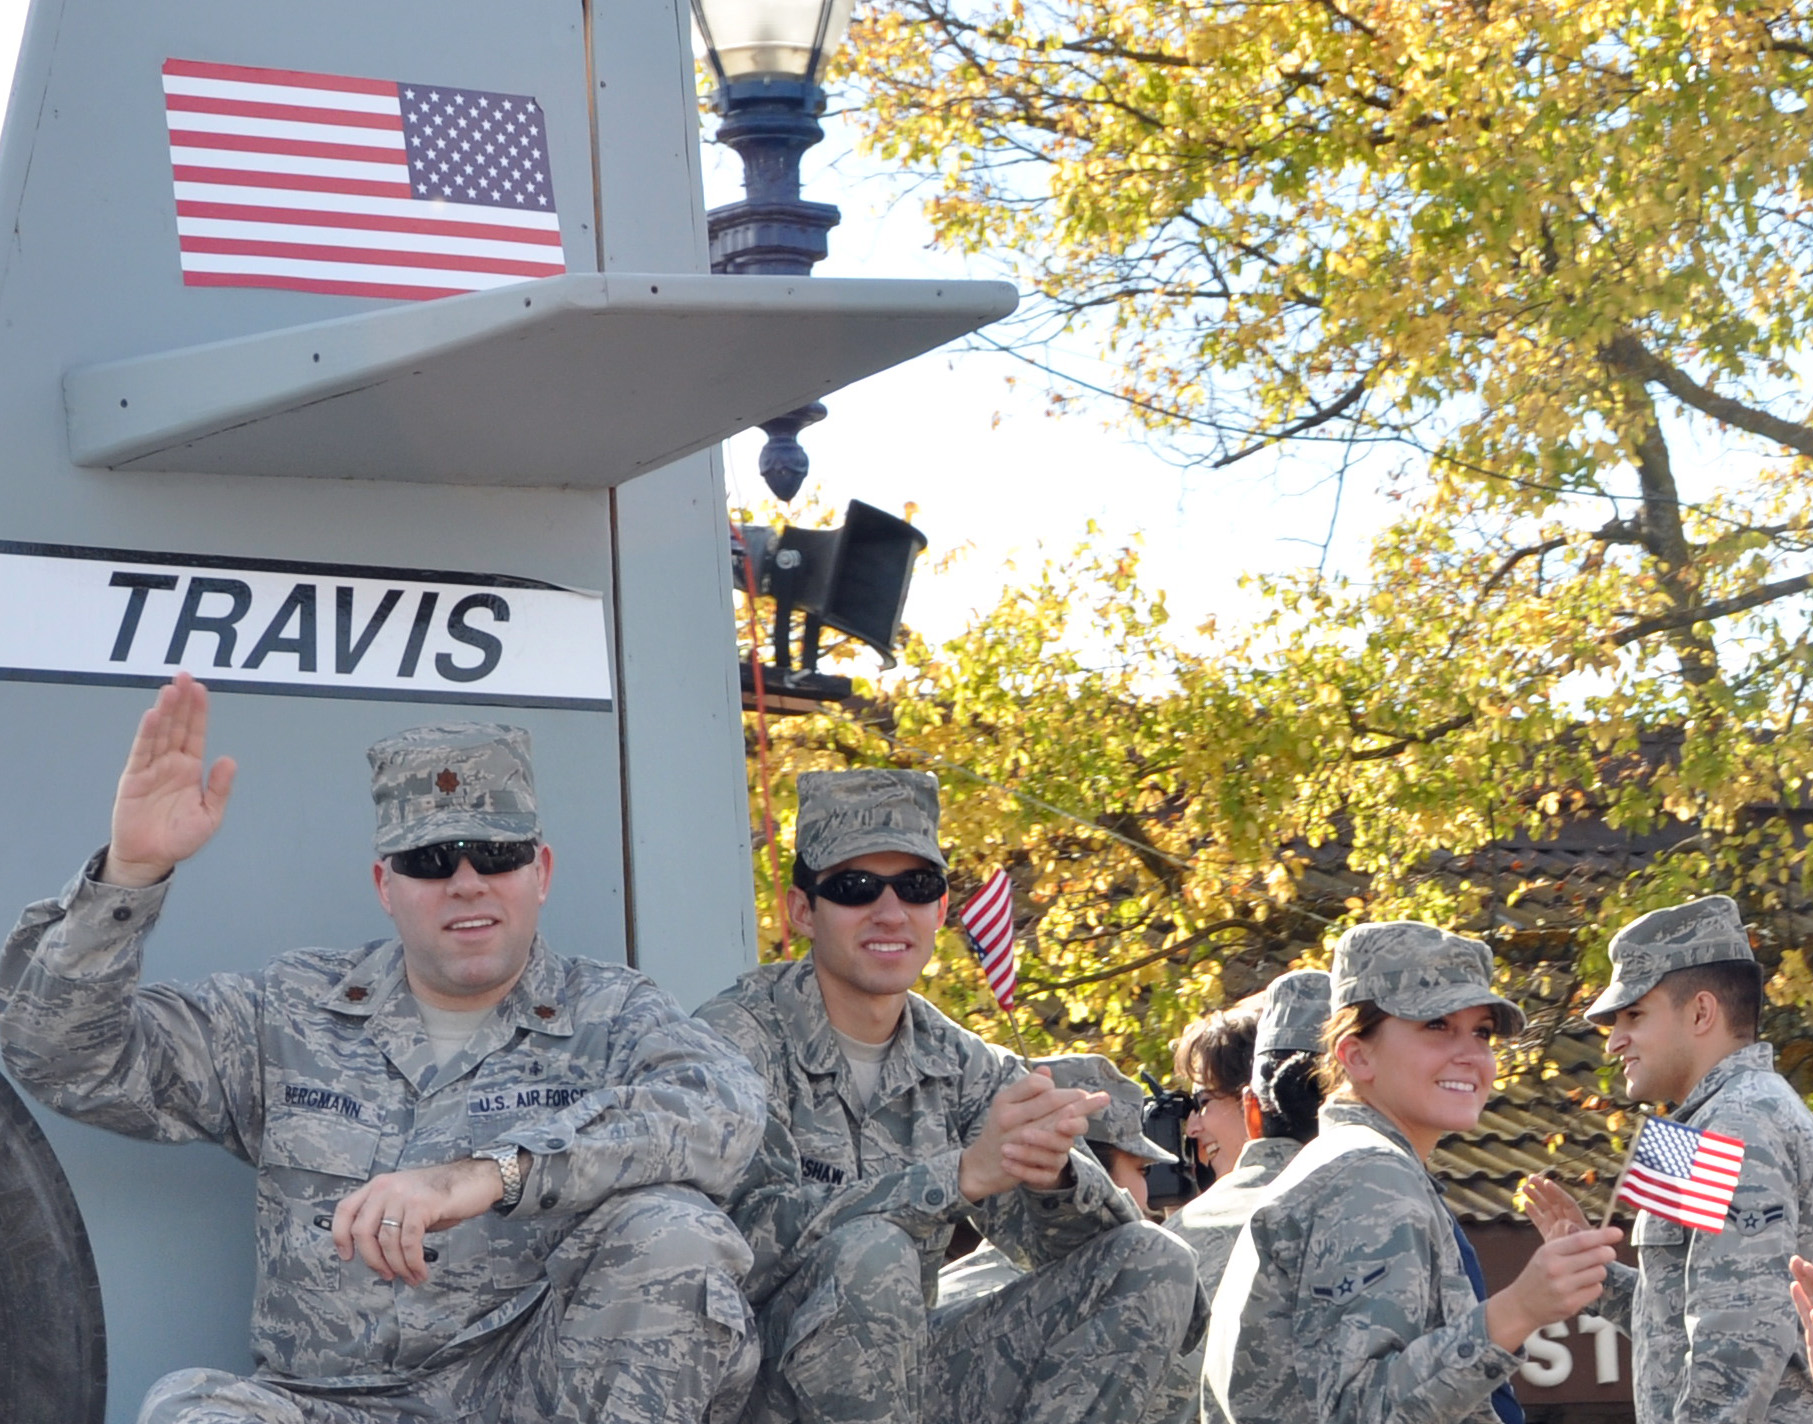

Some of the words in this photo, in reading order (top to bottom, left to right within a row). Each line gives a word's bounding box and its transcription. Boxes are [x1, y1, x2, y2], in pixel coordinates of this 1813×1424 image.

[108, 571, 511, 683] TRAVIS
[285, 1085, 362, 1118] BERGMANN
[480, 1095, 510, 1112] U.S.
[517, 1089, 540, 1107] AIR
